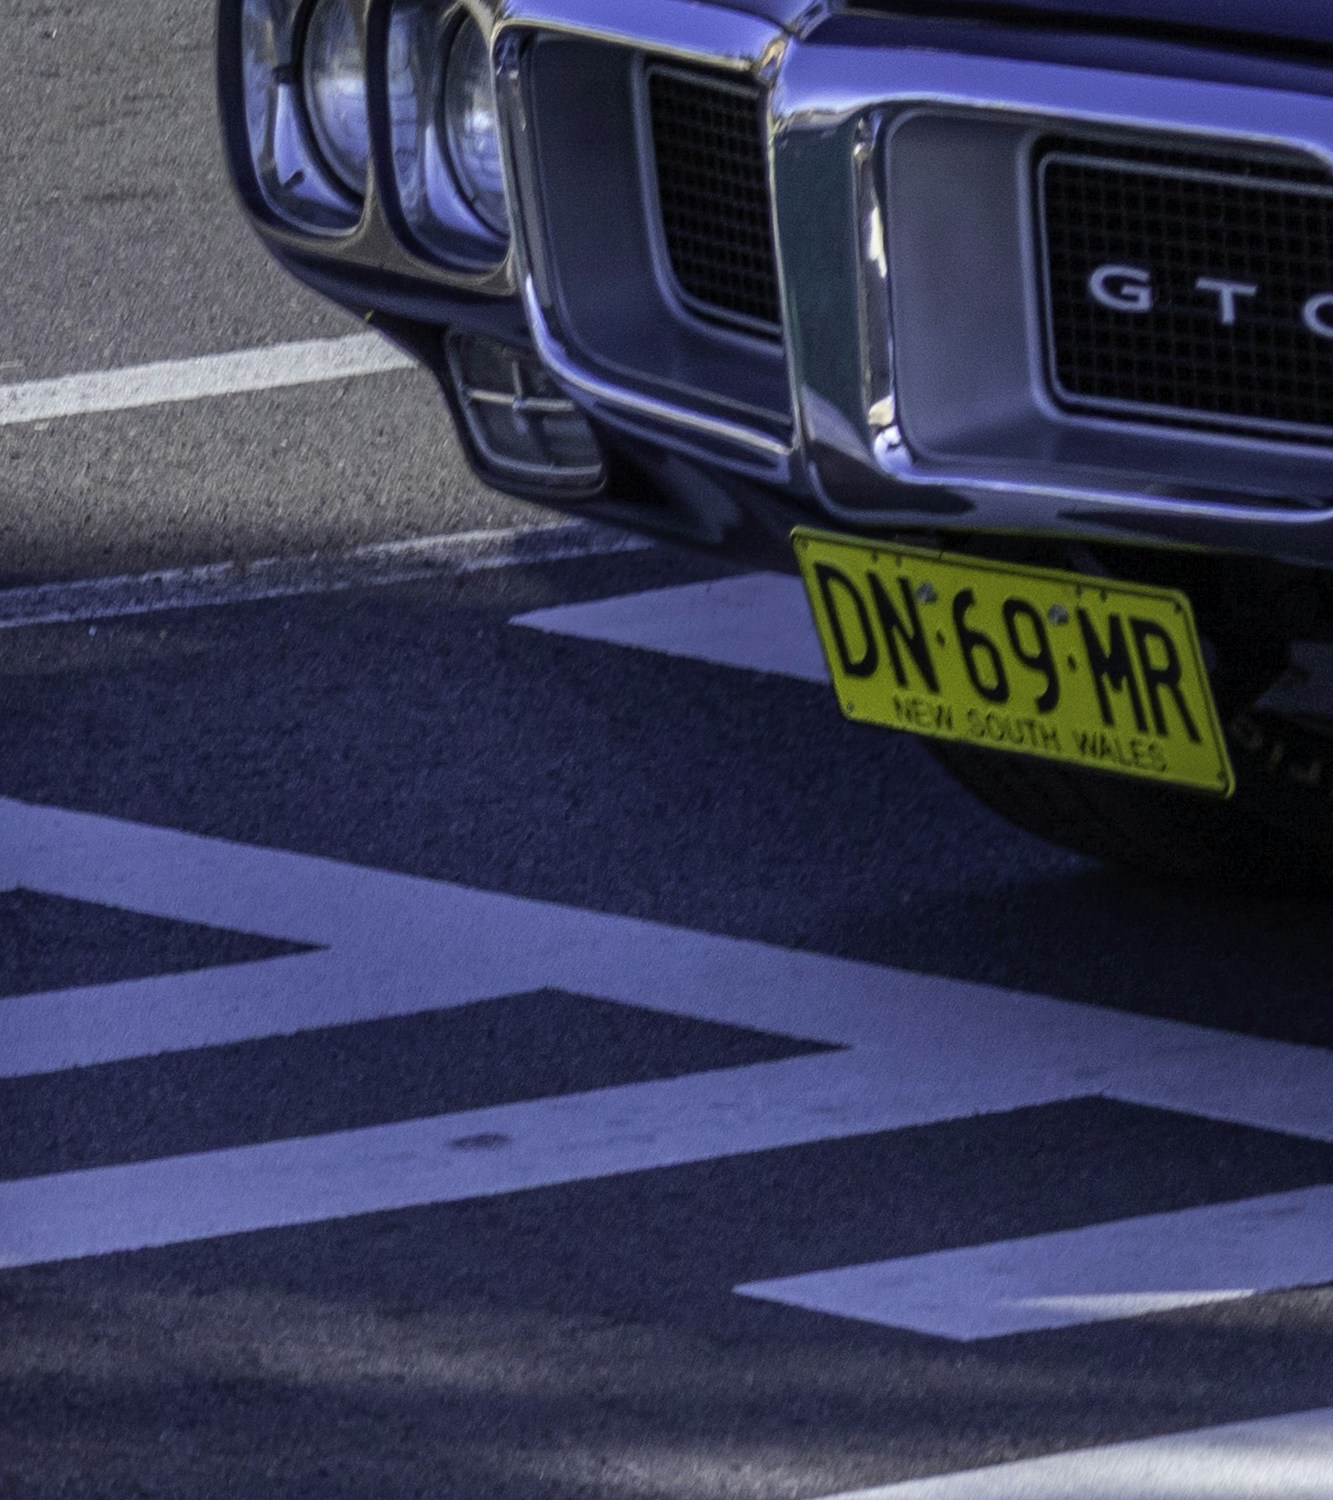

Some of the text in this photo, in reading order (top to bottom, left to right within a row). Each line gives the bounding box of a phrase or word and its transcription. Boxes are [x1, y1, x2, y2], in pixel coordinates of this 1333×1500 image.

[893, 695, 1168, 773] NEW SOUTH WALES
